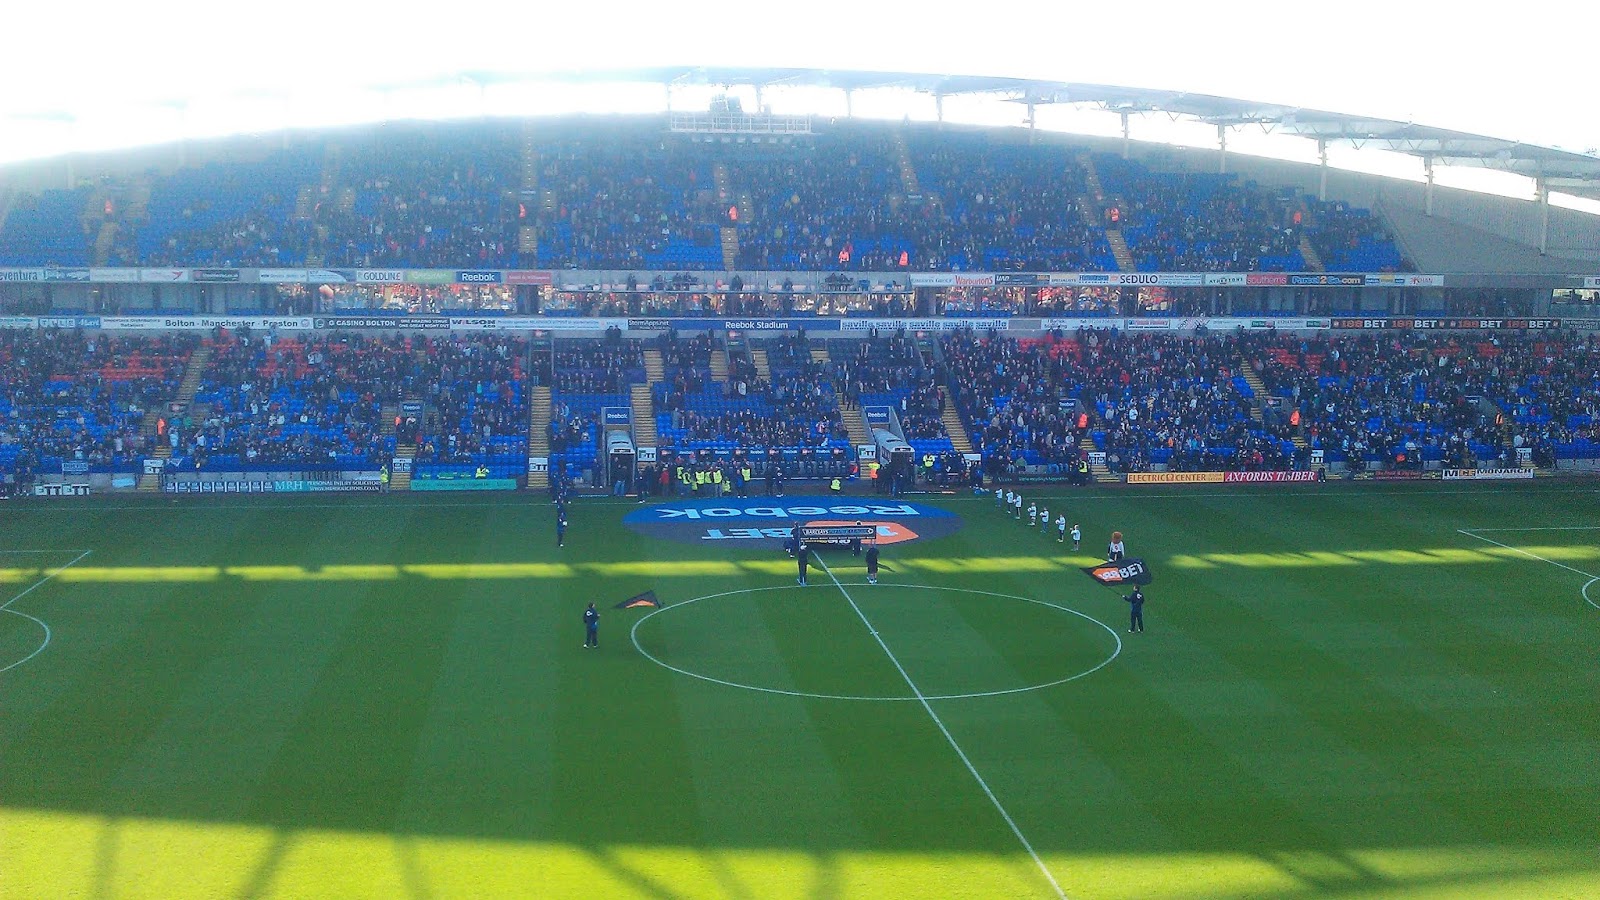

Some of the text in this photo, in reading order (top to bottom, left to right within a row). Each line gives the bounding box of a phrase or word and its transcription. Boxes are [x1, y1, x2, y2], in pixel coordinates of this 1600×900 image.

[363, 272, 400, 281] GOLDLINE
[461, 273, 495, 281] Reebok
[955, 275, 993, 285] Warburtons
[1120, 275, 1159, 284] SEDULO
[165, 319, 195, 327] Bolton
[263, 319, 298, 327] Preston
[725, 321, 789, 329] Reebok Stadium
[842, 320, 873, 328] saville
[875, 320, 907, 328] saville
[909, 320, 941, 328] saville
[976, 320, 1007, 328] saville
[1342, 320, 1387, 328] 188BET
[1392, 320, 1437, 328] 188BET
[1458, 320, 1502, 328] 188BET
[1506, 320, 1551, 328] 188BET
[1128, 474, 1167, 482] ELECTRIC
[1226, 472, 1274, 481] AXFORDS
[275, 481, 302, 489] MRH
[656, 506, 920, 519] Reebok
